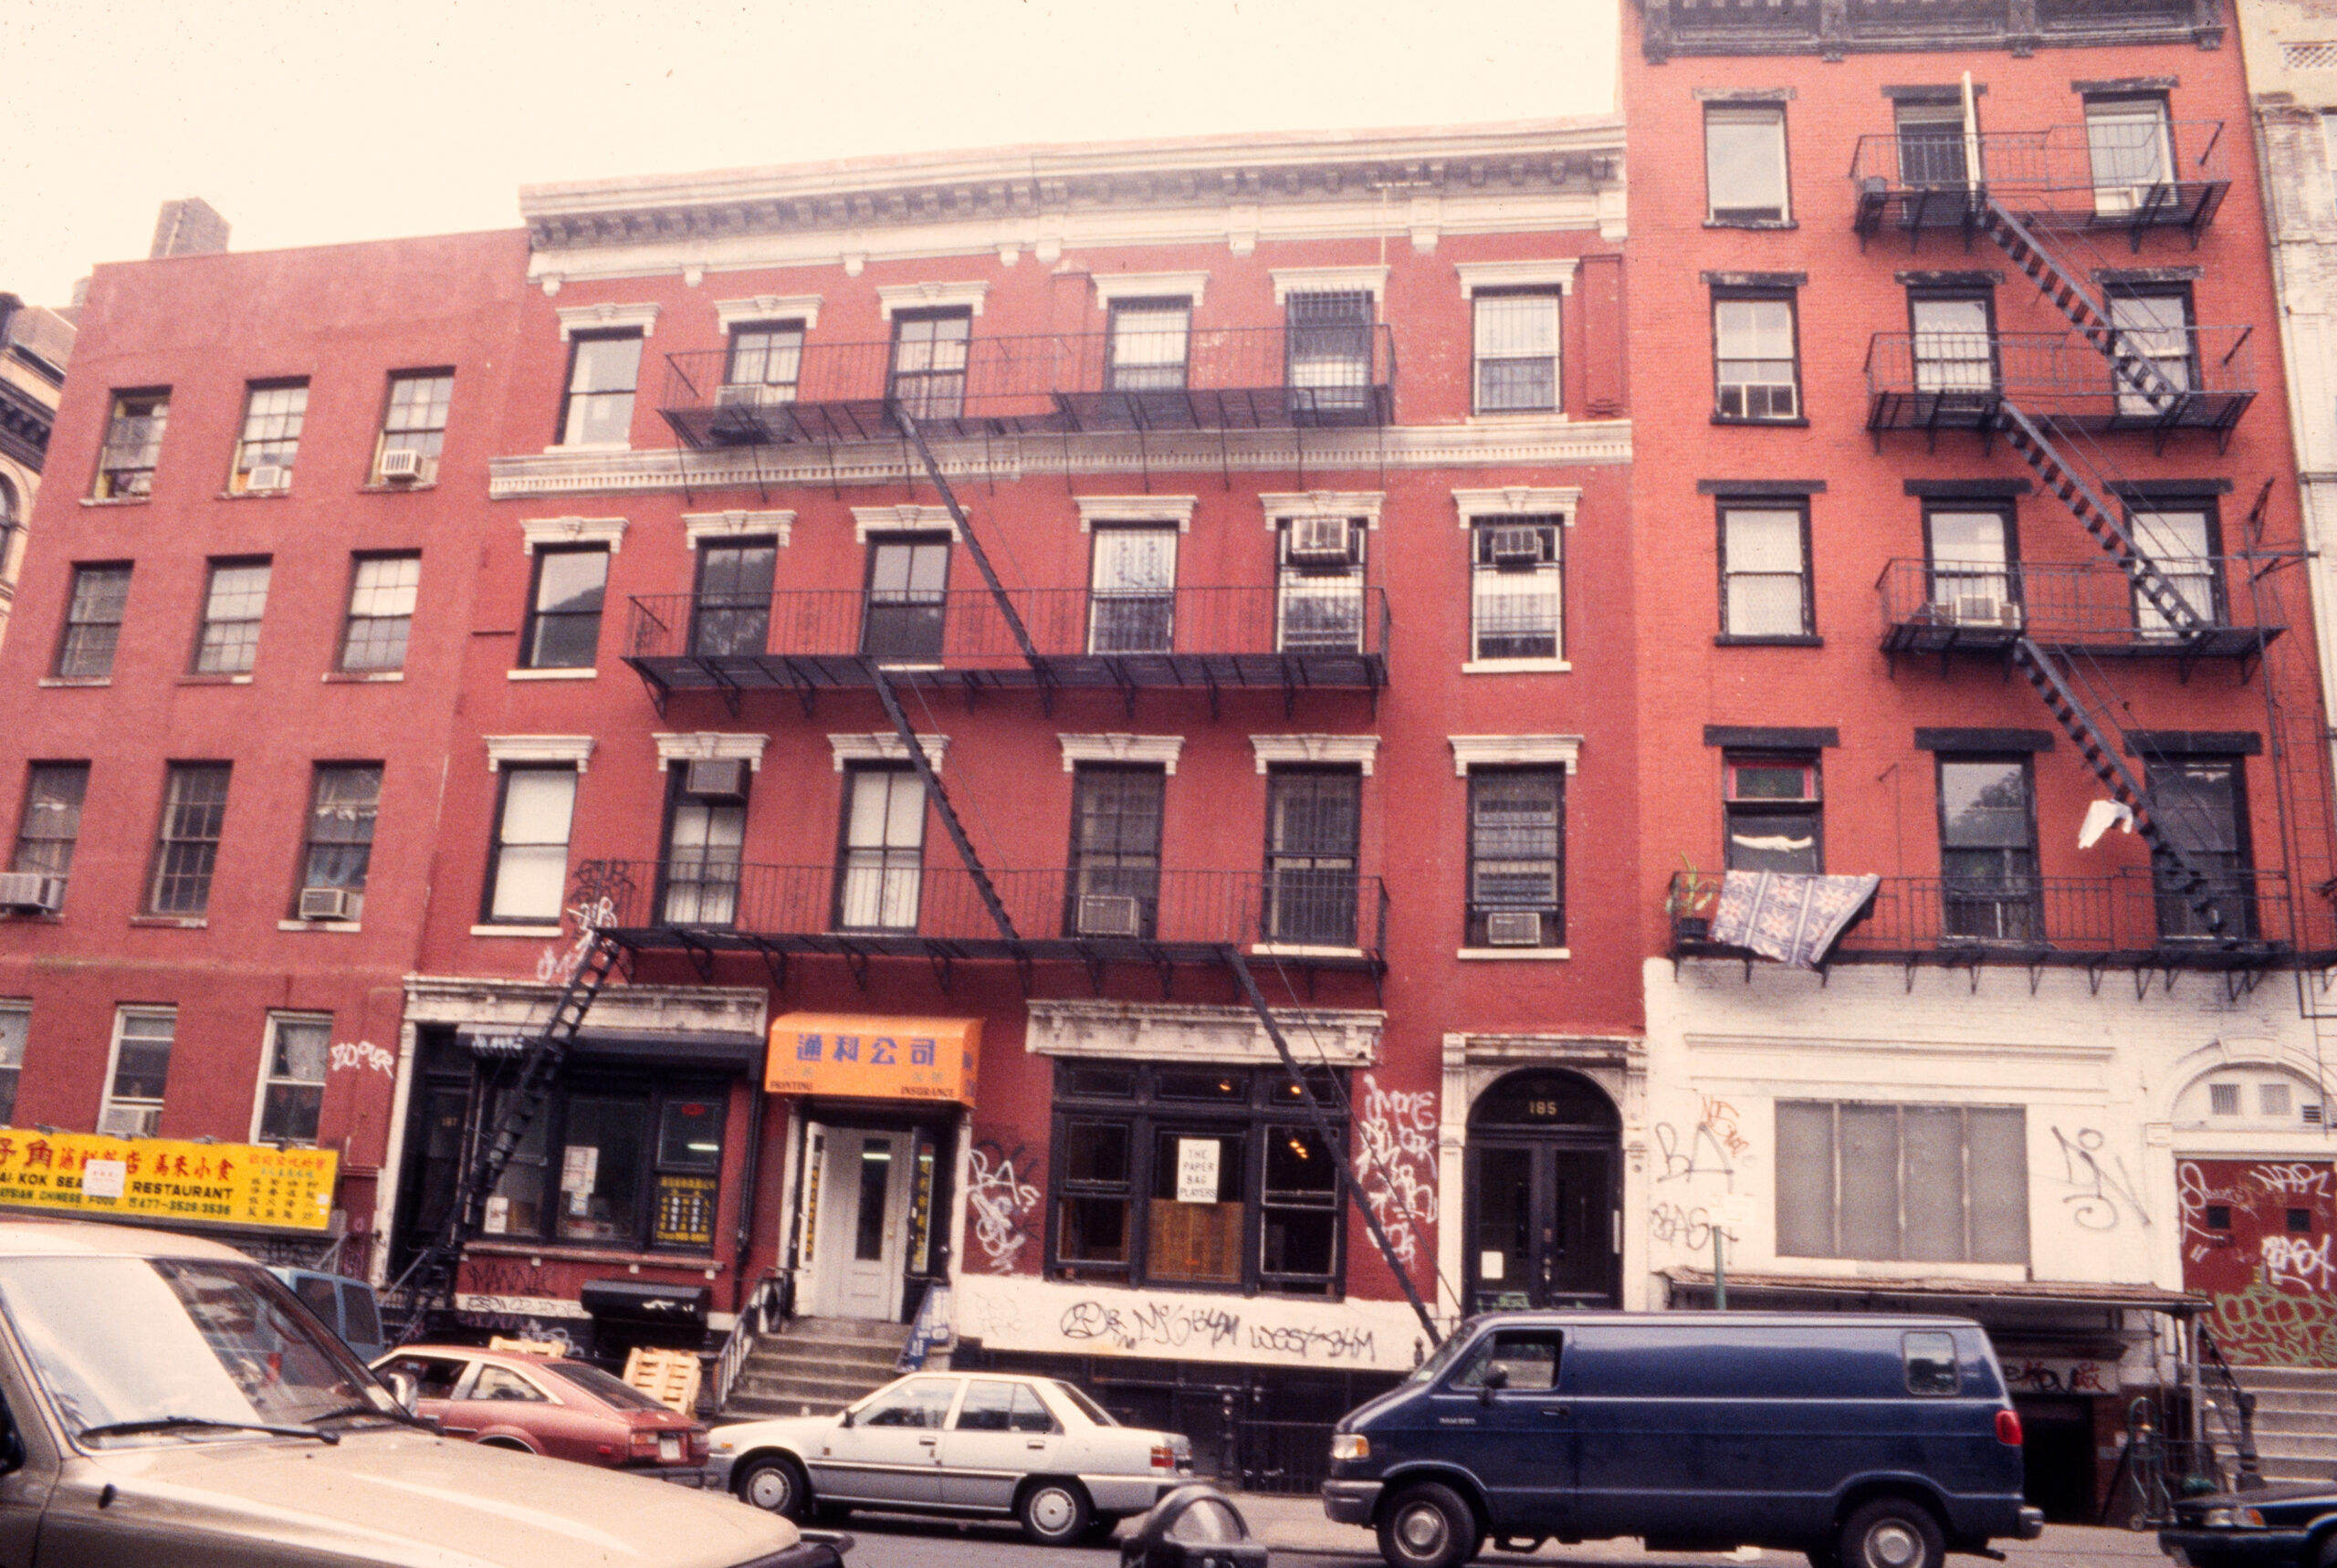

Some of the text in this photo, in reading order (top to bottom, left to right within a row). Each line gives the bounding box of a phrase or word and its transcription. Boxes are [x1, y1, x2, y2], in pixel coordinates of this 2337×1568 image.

[770, 1081, 813, 1091] PRINTING
[901, 1086, 954, 1097] INSURANCE
[1529, 1101, 1557, 1114] 185
[1188, 1149, 1207, 1160] THE
[1183, 1162, 1214, 1173] PAPER
[1187, 1175, 1206, 1185] BAG
[18, 1173, 47, 1186] KOK
[132, 1180, 233, 1199] RESTAURANT
[40, 1190, 81, 1204] CHINESE
[1179, 1187, 1217, 1198] PLAYERS
